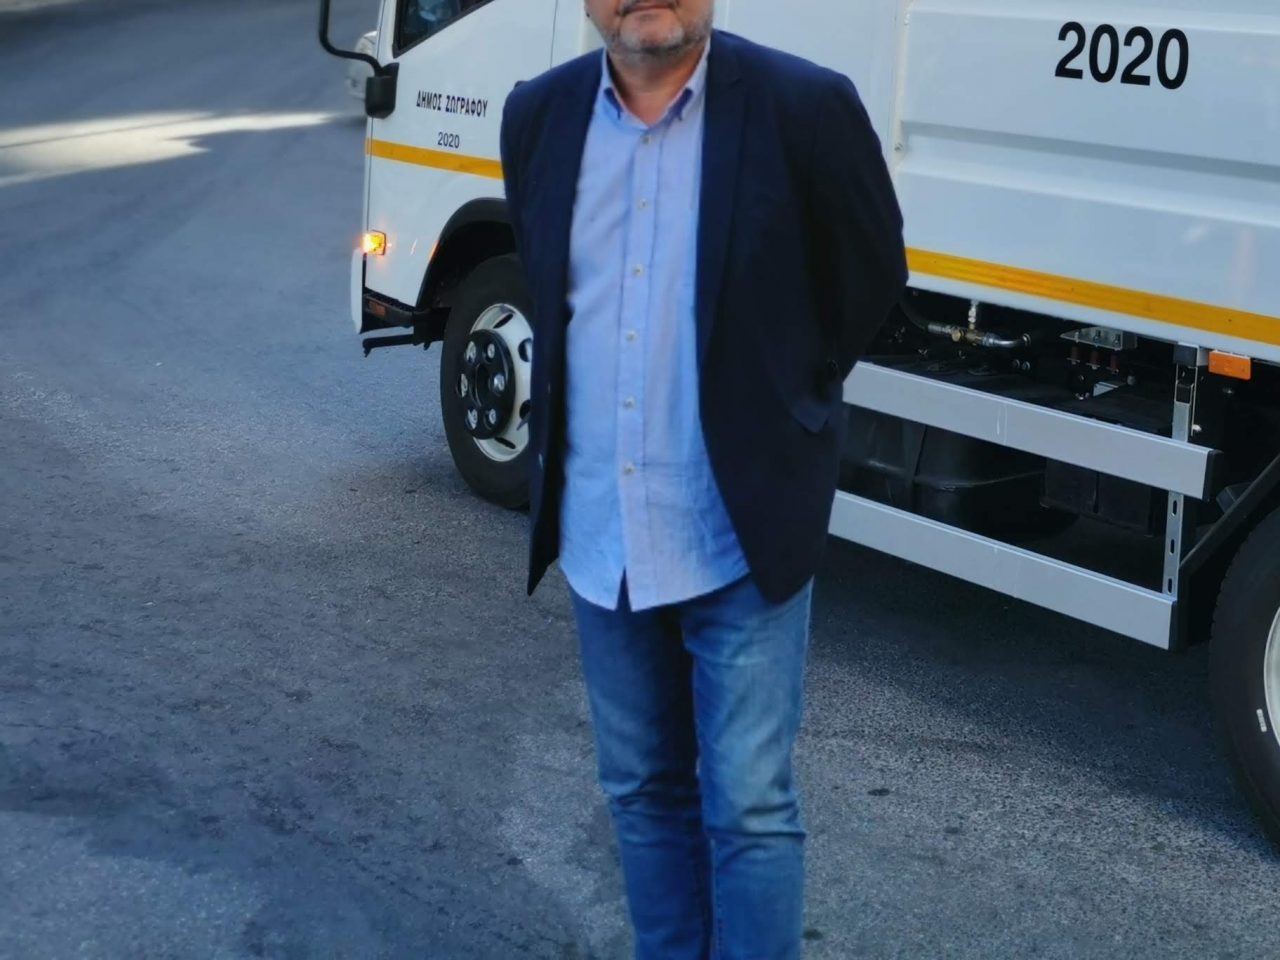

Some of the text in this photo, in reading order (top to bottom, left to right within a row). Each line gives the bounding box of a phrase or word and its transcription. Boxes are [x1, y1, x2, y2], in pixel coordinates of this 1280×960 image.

[1054, 20, 1190, 90] 2020
[416, 90, 488, 117] ΔΗΜΟΣ ΖΩΓΡΑΦΟΥ
[437, 131, 460, 149] 2020
